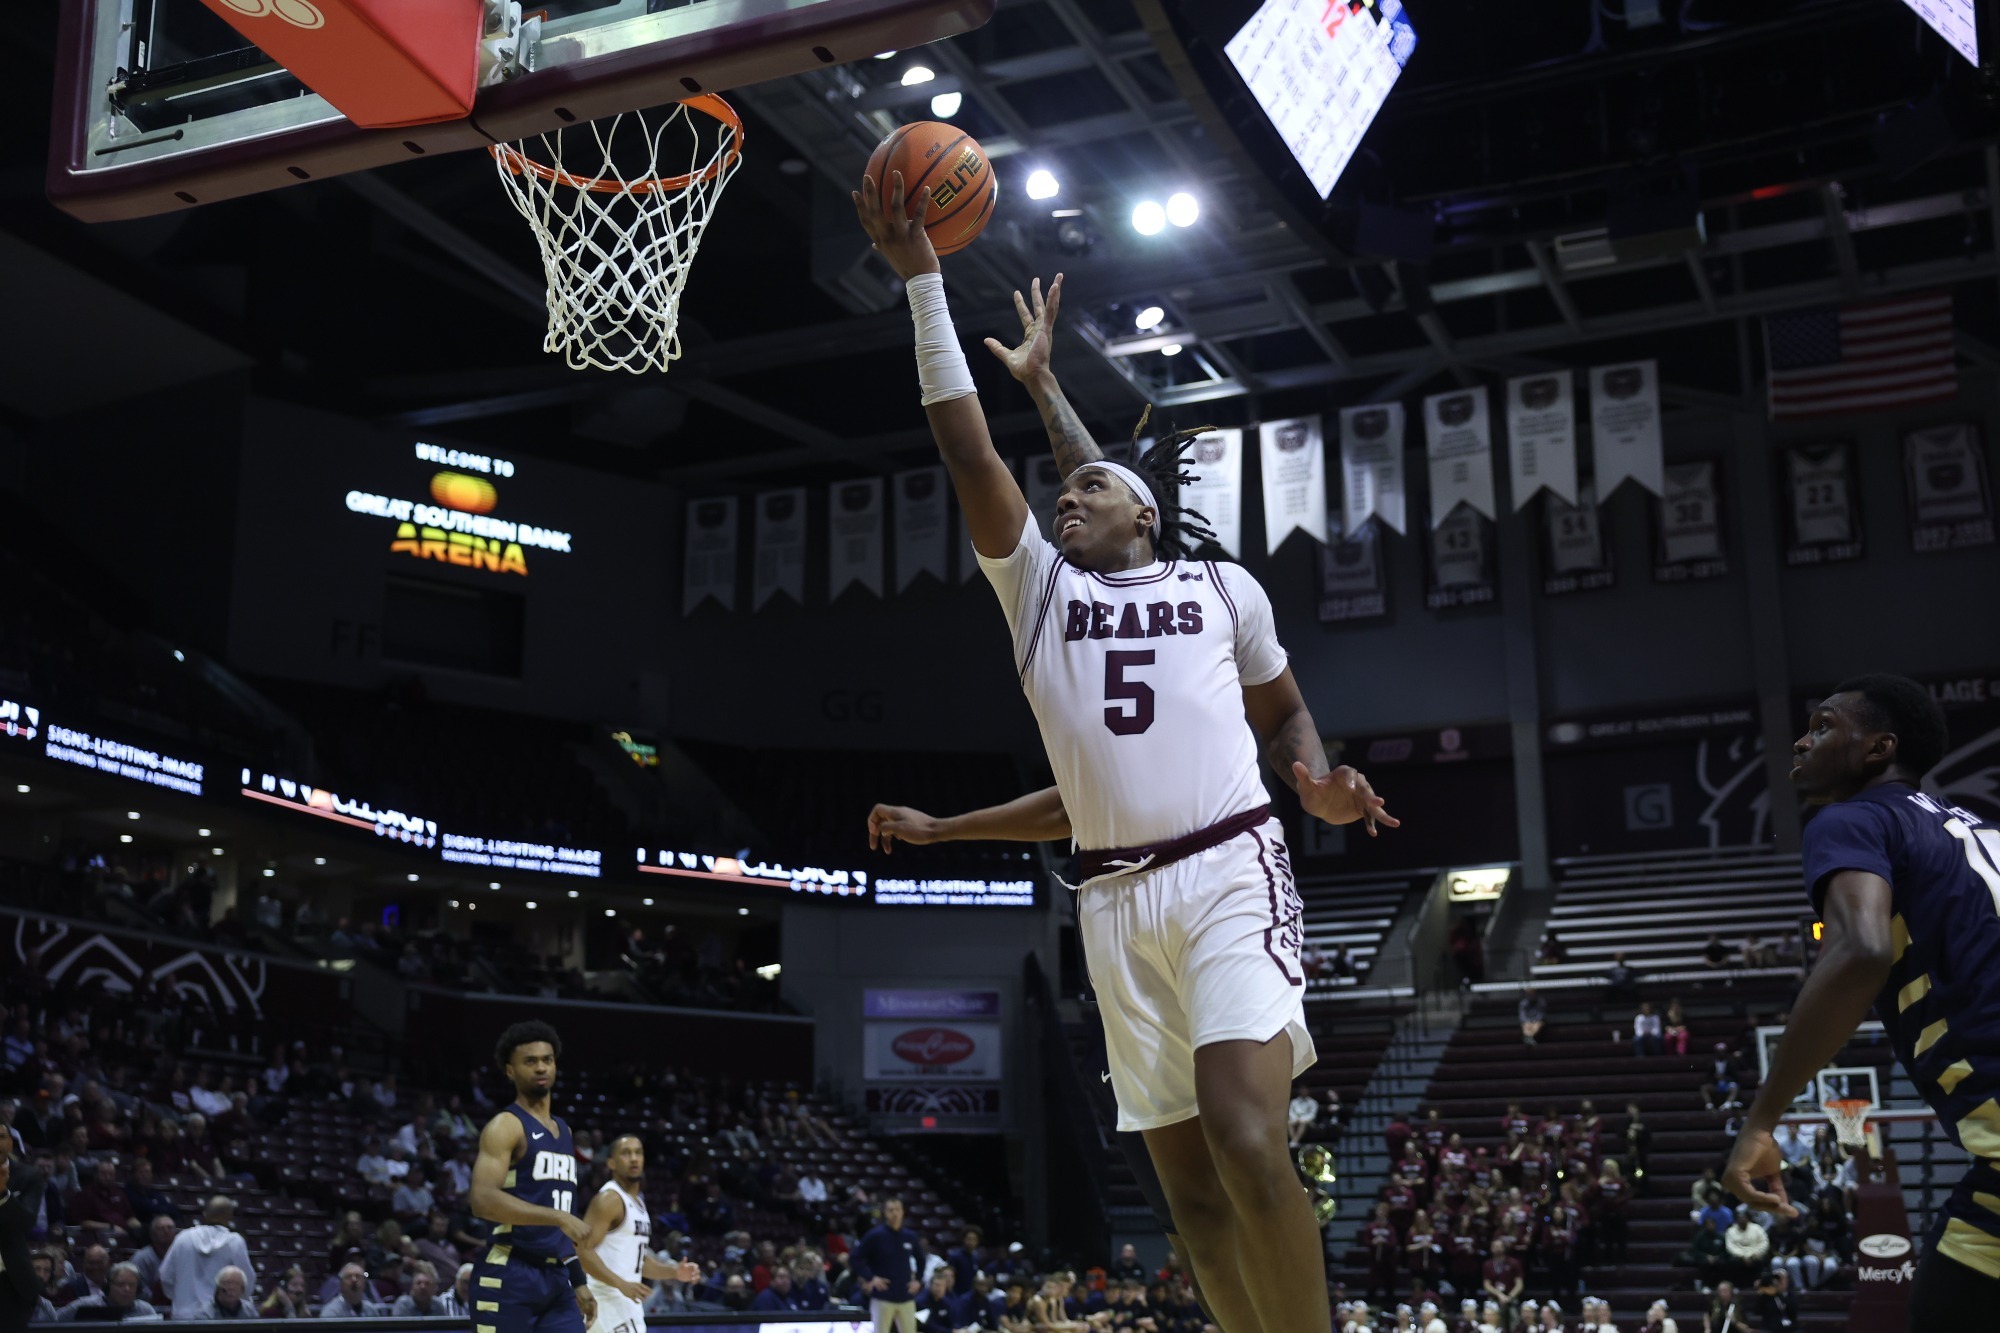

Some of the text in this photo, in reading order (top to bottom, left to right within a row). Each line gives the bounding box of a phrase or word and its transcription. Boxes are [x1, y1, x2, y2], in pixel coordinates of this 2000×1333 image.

[930, 148, 983, 209] ELITE
[415, 442, 515, 478] WELCOME TO
[345, 490, 572, 553] GREAT SOUTHERN BANK
[390, 522, 529, 577] ARENA
[332, 618, 378, 660] FF
[1065, 599, 1203, 642] BEARS
[821, 689, 883, 724] GG
[1104, 649, 1156, 736] 5
[1588, 710, 1753, 737] GREAT SOUTHERN BANK
[1634, 788, 1667, 816] G
[1858, 1266, 1904, 1284] Mercy
